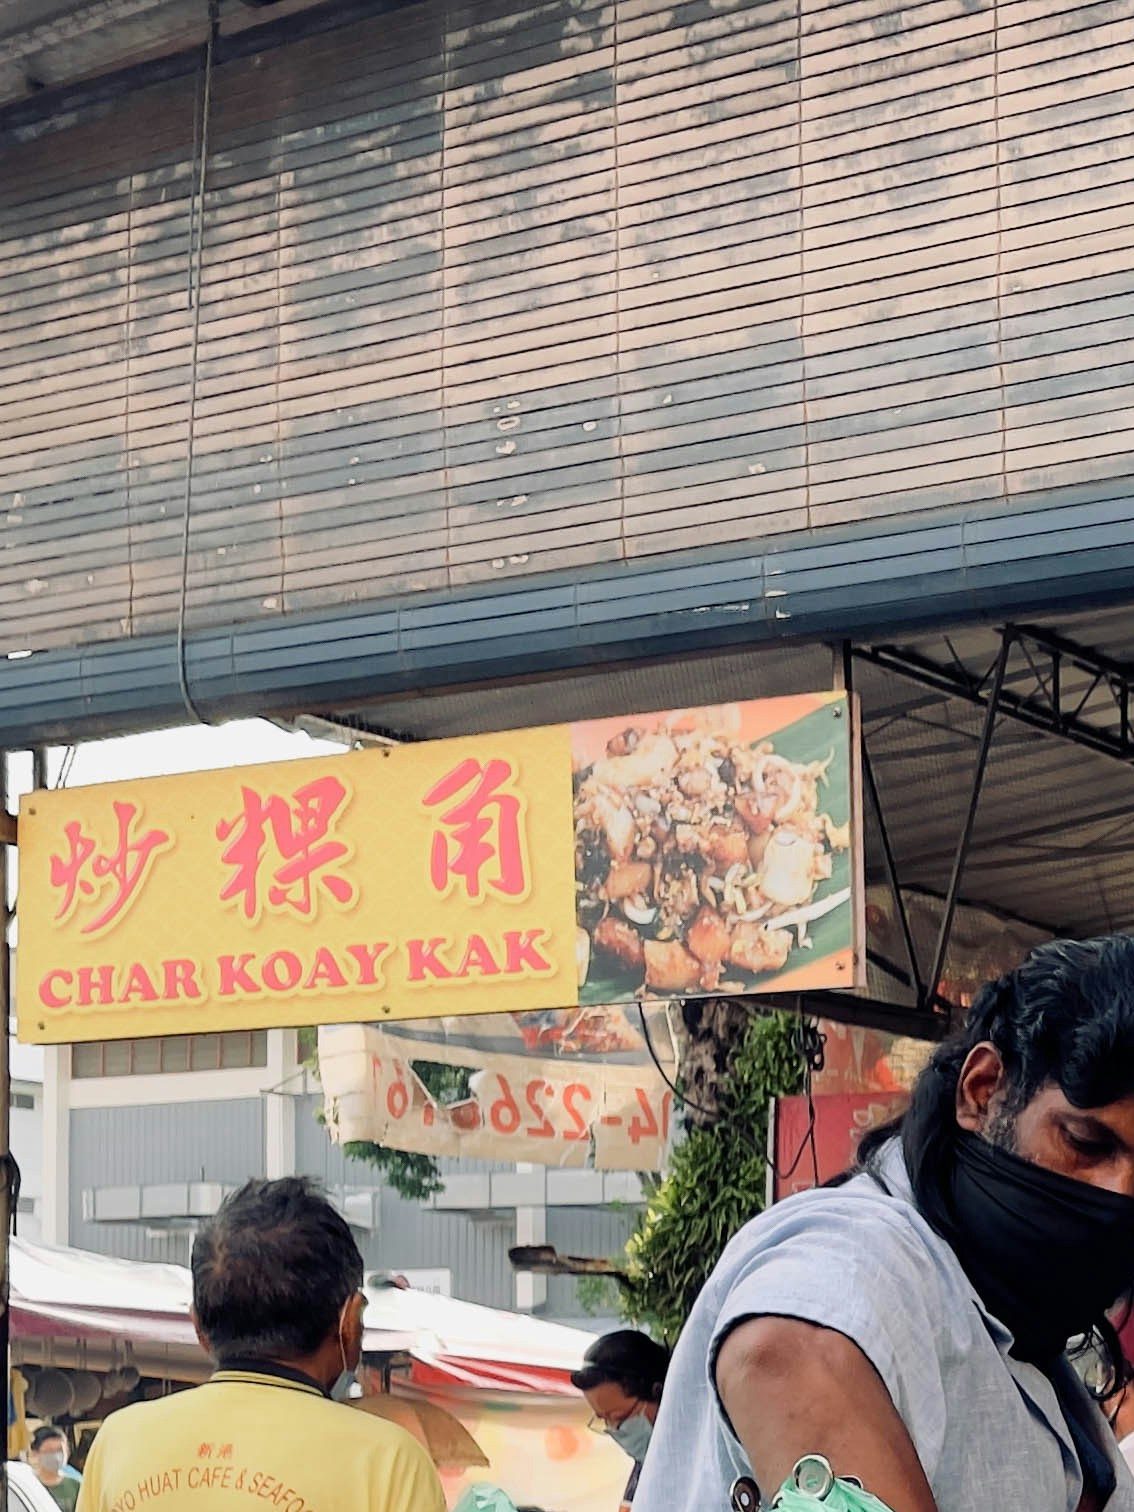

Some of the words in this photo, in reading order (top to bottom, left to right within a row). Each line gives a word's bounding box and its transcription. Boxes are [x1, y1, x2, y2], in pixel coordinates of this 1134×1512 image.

[50, 757, 528, 935] 炒粿角
[38, 959, 201, 1010] CHAR
[217, 941, 389, 996] KOAY
[406, 927, 553, 981] KAK
[138, 1468, 183, 1503] HUAT
[188, 1466, 234, 1490] CAFE
